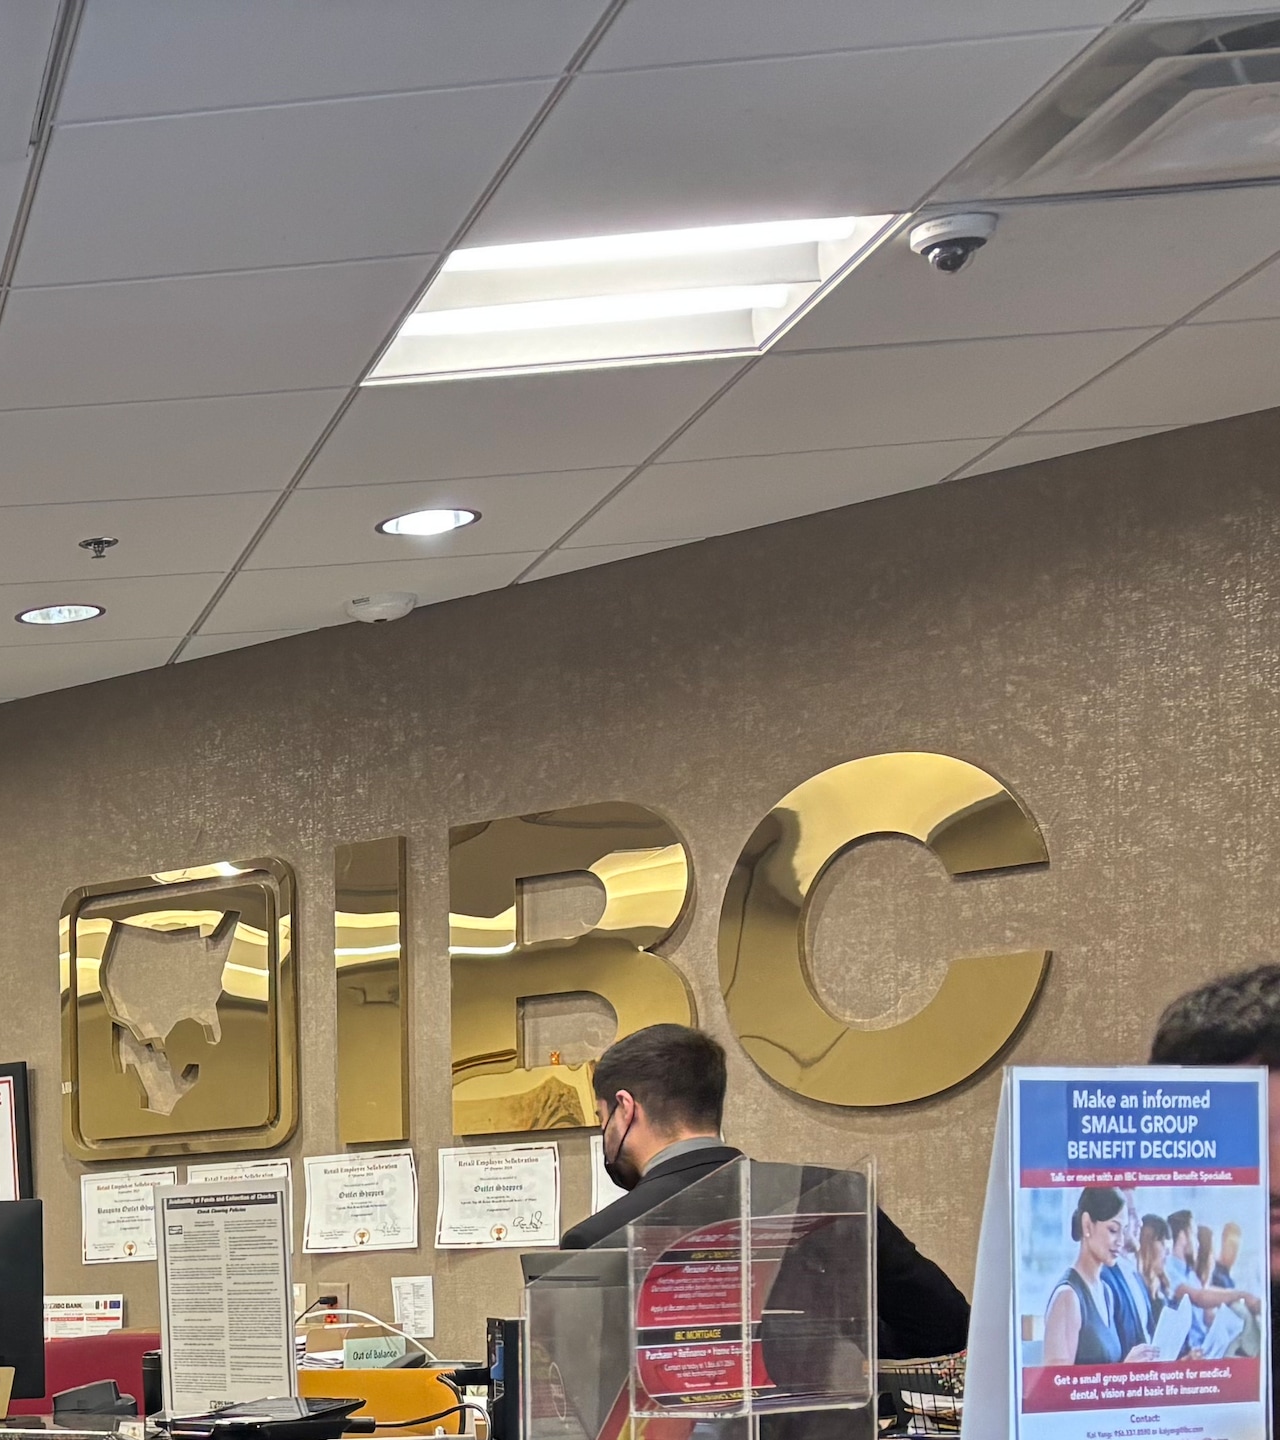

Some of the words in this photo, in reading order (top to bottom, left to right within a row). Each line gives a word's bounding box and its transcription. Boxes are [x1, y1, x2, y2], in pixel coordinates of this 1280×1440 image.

[334, 751, 1050, 1142] IBC
[1072, 1089, 1117, 1109] Make
[1120, 1092, 1138, 1109] an
[1142, 1089, 1211, 1109] informed
[1081, 1115, 1137, 1134] SMALL
[1140, 1115, 1198, 1134] GROUP
[1067, 1140, 1137, 1160] BENEFIT
[1140, 1140, 1217, 1160] DECISION
[1050, 1173, 1065, 1182] Talk
[1076, 1174, 1095, 1182] meet
[1096, 1173, 1113, 1182] with
[1139, 1172, 1171, 1181] Insurance
[1173, 1172, 1199, 1181] Benefit
[1199, 1171, 1233, 1182] Specialist.
[687, 1329, 722, 1340] MORTGAGE
[353, 1351, 364, 1360] Out
[365, 1349, 372, 1359] of
[373, 1349, 398, 1359] Balance
[1053, 1374, 1071, 1387] Get
[1072, 1376, 1078, 1385] a
[1079, 1373, 1102, 1385] small
[1102, 1373, 1128, 1387] group
[1129, 1370, 1159, 1383] benefit
[1160, 1372, 1184, 1384] quote
[1185, 1368, 1198, 1380] for
[1199, 1367, 1232, 1381] medical,
[1070, 1388, 1099, 1402] dental,
[1100, 1387, 1125, 1399] vision
[1126, 1387, 1143, 1398] and
[1143, 1385, 1164, 1397] basic
[1165, 1384, 1178, 1396] life
[1179, 1383, 1221, 1396] insurance.
[1130, 1414, 1161, 1424] Contact:
